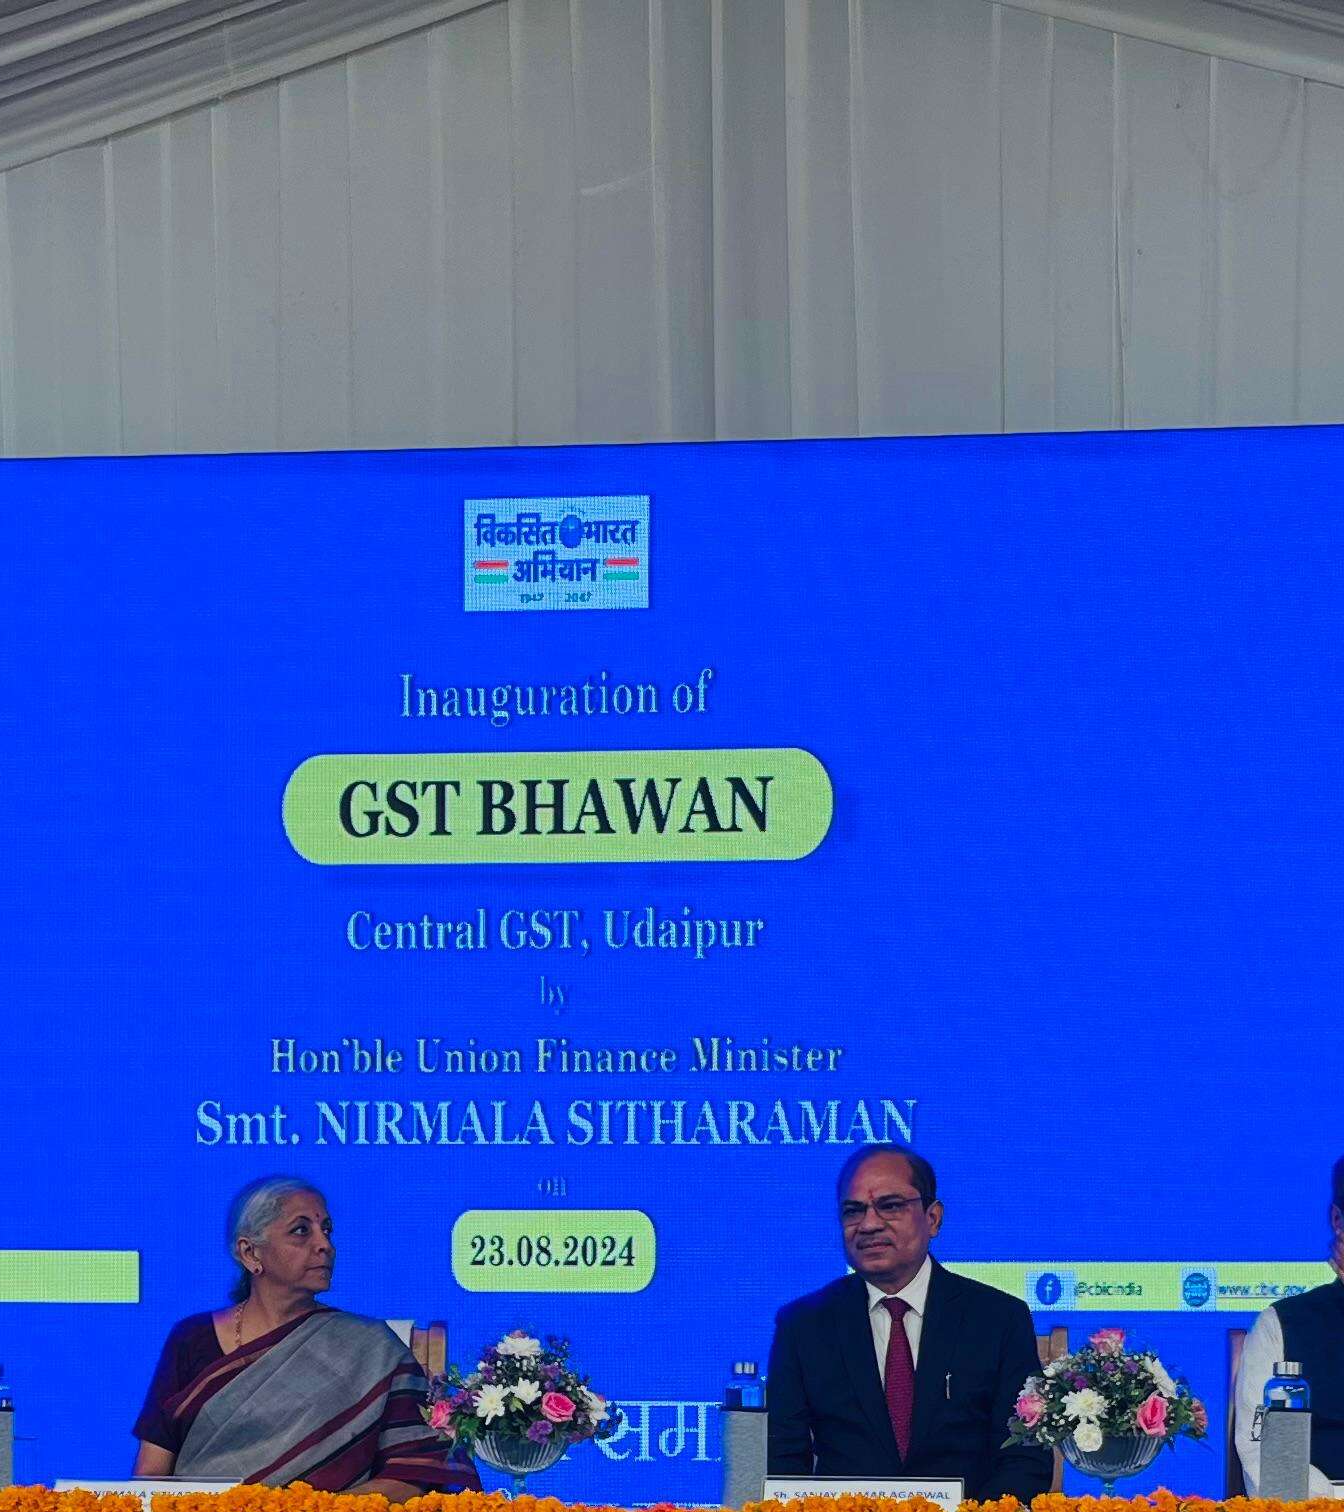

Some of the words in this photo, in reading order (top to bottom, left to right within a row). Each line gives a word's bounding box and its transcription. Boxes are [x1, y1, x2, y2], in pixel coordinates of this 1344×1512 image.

[474, 512, 559, 548] विकसित
[582, 520, 639, 545] भारत
[513, 549, 600, 583] अभियान
[400, 670, 658, 728] Inauguration
[672, 668, 714, 714] of
[338, 778, 461, 839] GST
[475, 774, 775, 838] BHAWAN
[345, 908, 488, 952] Central
[498, 910, 591, 960] GST,
[602, 906, 766, 960] Udaipur
[270, 1037, 404, 1075] Hon'ble
[416, 1038, 523, 1075] Union
[536, 1037, 677, 1074] Finance
[689, 1037, 843, 1074] Minister
[195, 1100, 301, 1147] Smt.
[314, 1100, 556, 1146] NIRMALA
[566, 1098, 918, 1146] SITHARAMAN
[469, 1234, 636, 1269] 23.08.2024
